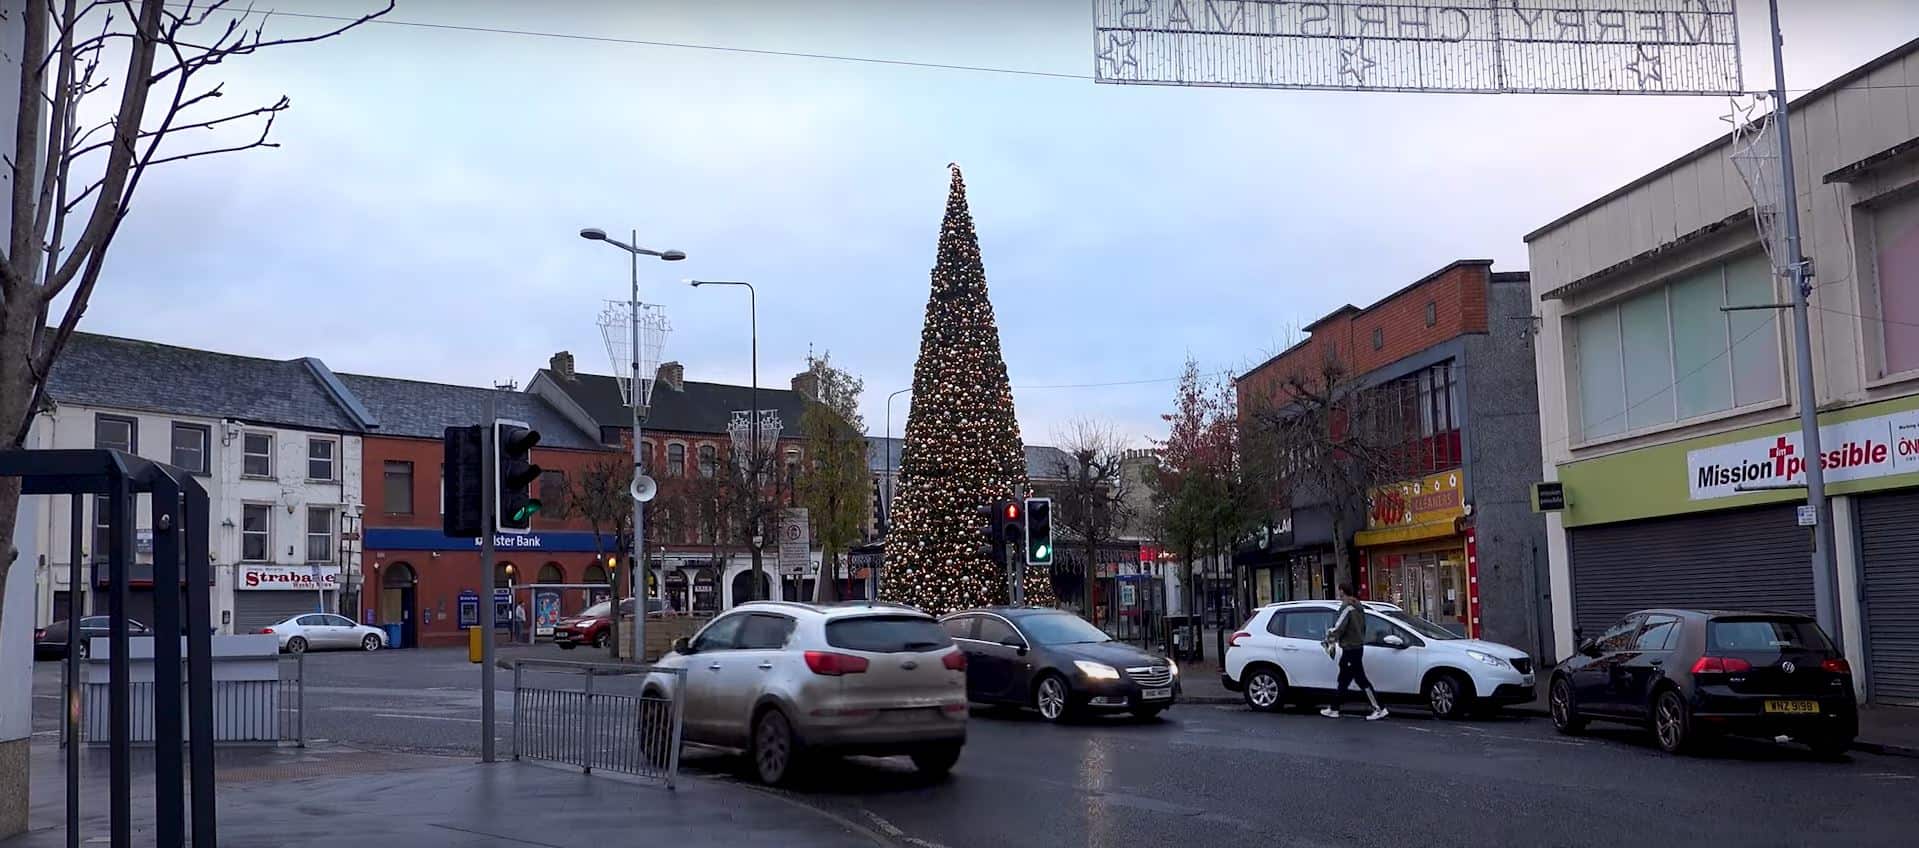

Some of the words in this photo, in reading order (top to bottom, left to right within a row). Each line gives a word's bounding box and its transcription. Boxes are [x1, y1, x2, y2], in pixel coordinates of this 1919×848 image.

[1698, 459, 1772, 488] Mission
[493, 535, 515, 546] lster
[516, 535, 541, 546] Bank
[245, 571, 335, 587] Strabae
